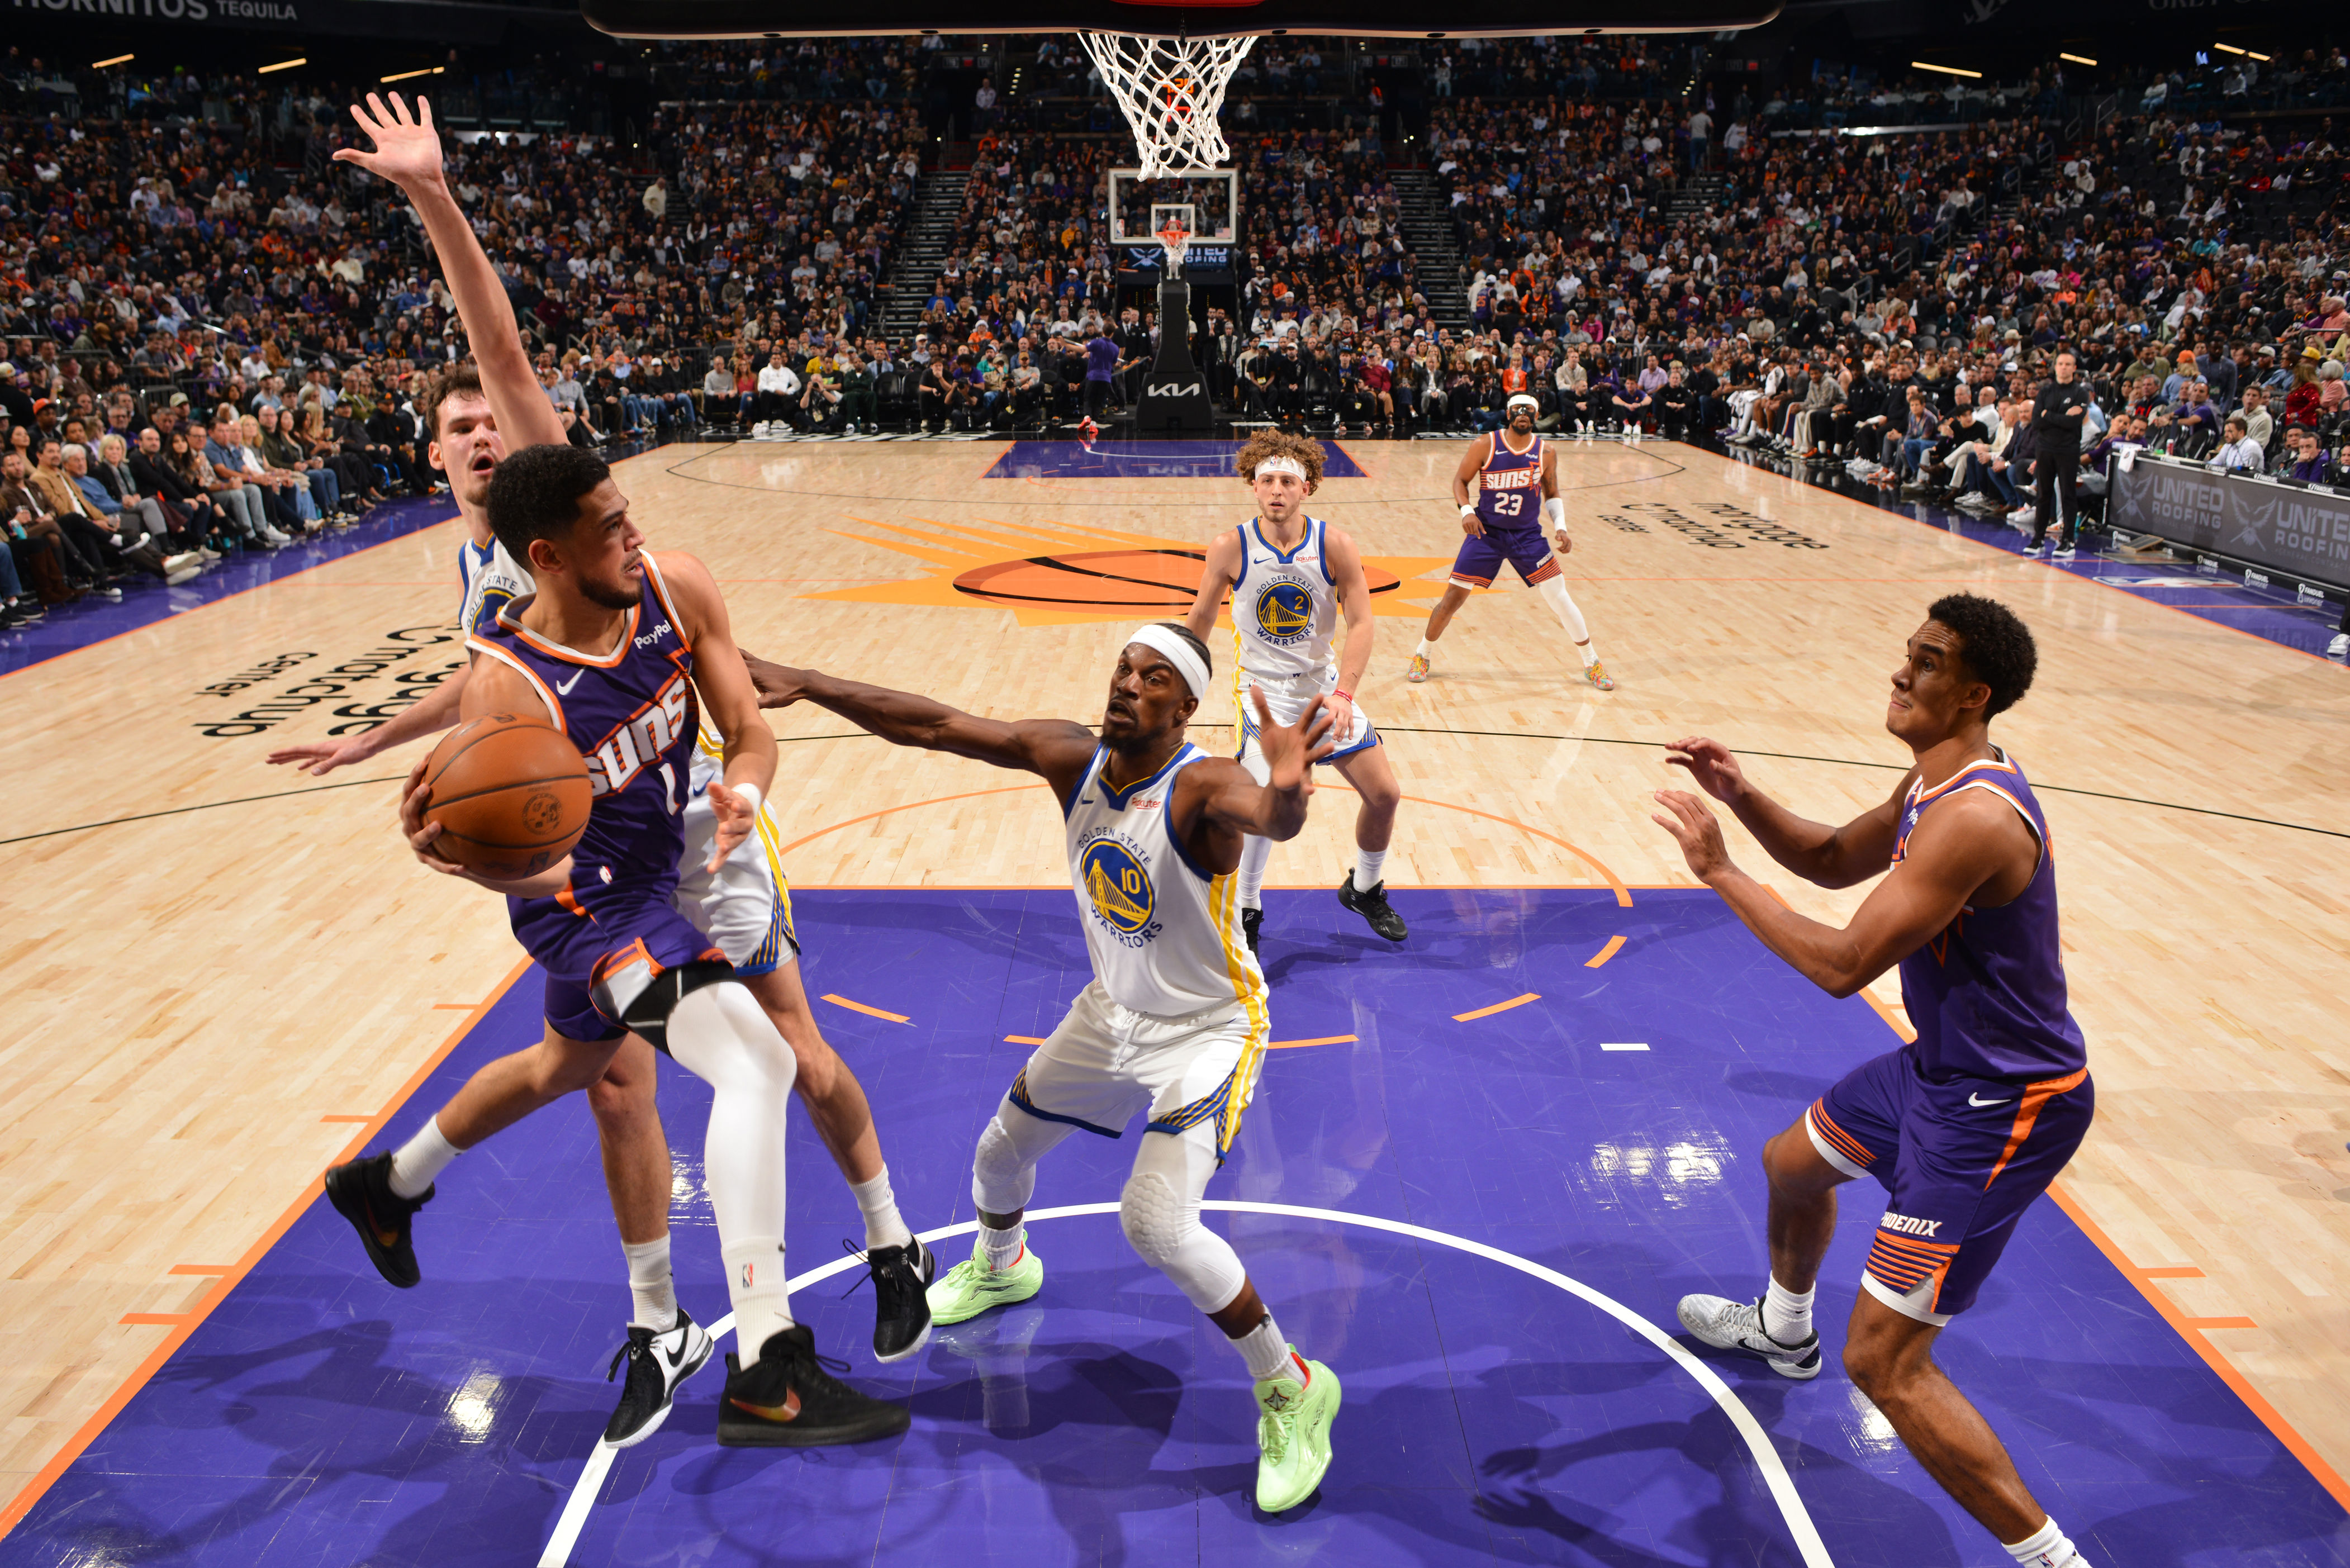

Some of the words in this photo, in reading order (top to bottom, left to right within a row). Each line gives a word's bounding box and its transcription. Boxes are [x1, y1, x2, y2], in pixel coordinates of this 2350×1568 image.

[15, 0, 207, 21] NITOS
[217, 1, 297, 20] TEQUILA
[1486, 470, 1531, 489] SUNS
[2153, 474, 2224, 512] UNITED
[1494, 492, 1523, 516] 23
[2152, 500, 2222, 530] ROOFING
[1597, 515, 1651, 533] center
[1646, 513, 1746, 548] matchup
[1691, 503, 1830, 549] mortgage
[2277, 501, 2350, 543] UNITE
[487, 575, 518, 590] STATE
[1256, 574, 1288, 595] GOLDEN
[1292, 576, 1314, 593] STATE
[1294, 596, 1304, 610] 2
[634, 620, 672, 649] PayPal
[1257, 622, 1315, 646] WARRIORS
[194, 652, 319, 697] center
[659, 763, 678, 816] 1
[1078, 826, 1115, 849] GOLDEN
[1119, 833, 1151, 866] STATE
[1121, 867, 1141, 894] 10
[1091, 902, 1163, 949] WARRIORS
[1881, 1211, 1943, 1237] HOENIX
